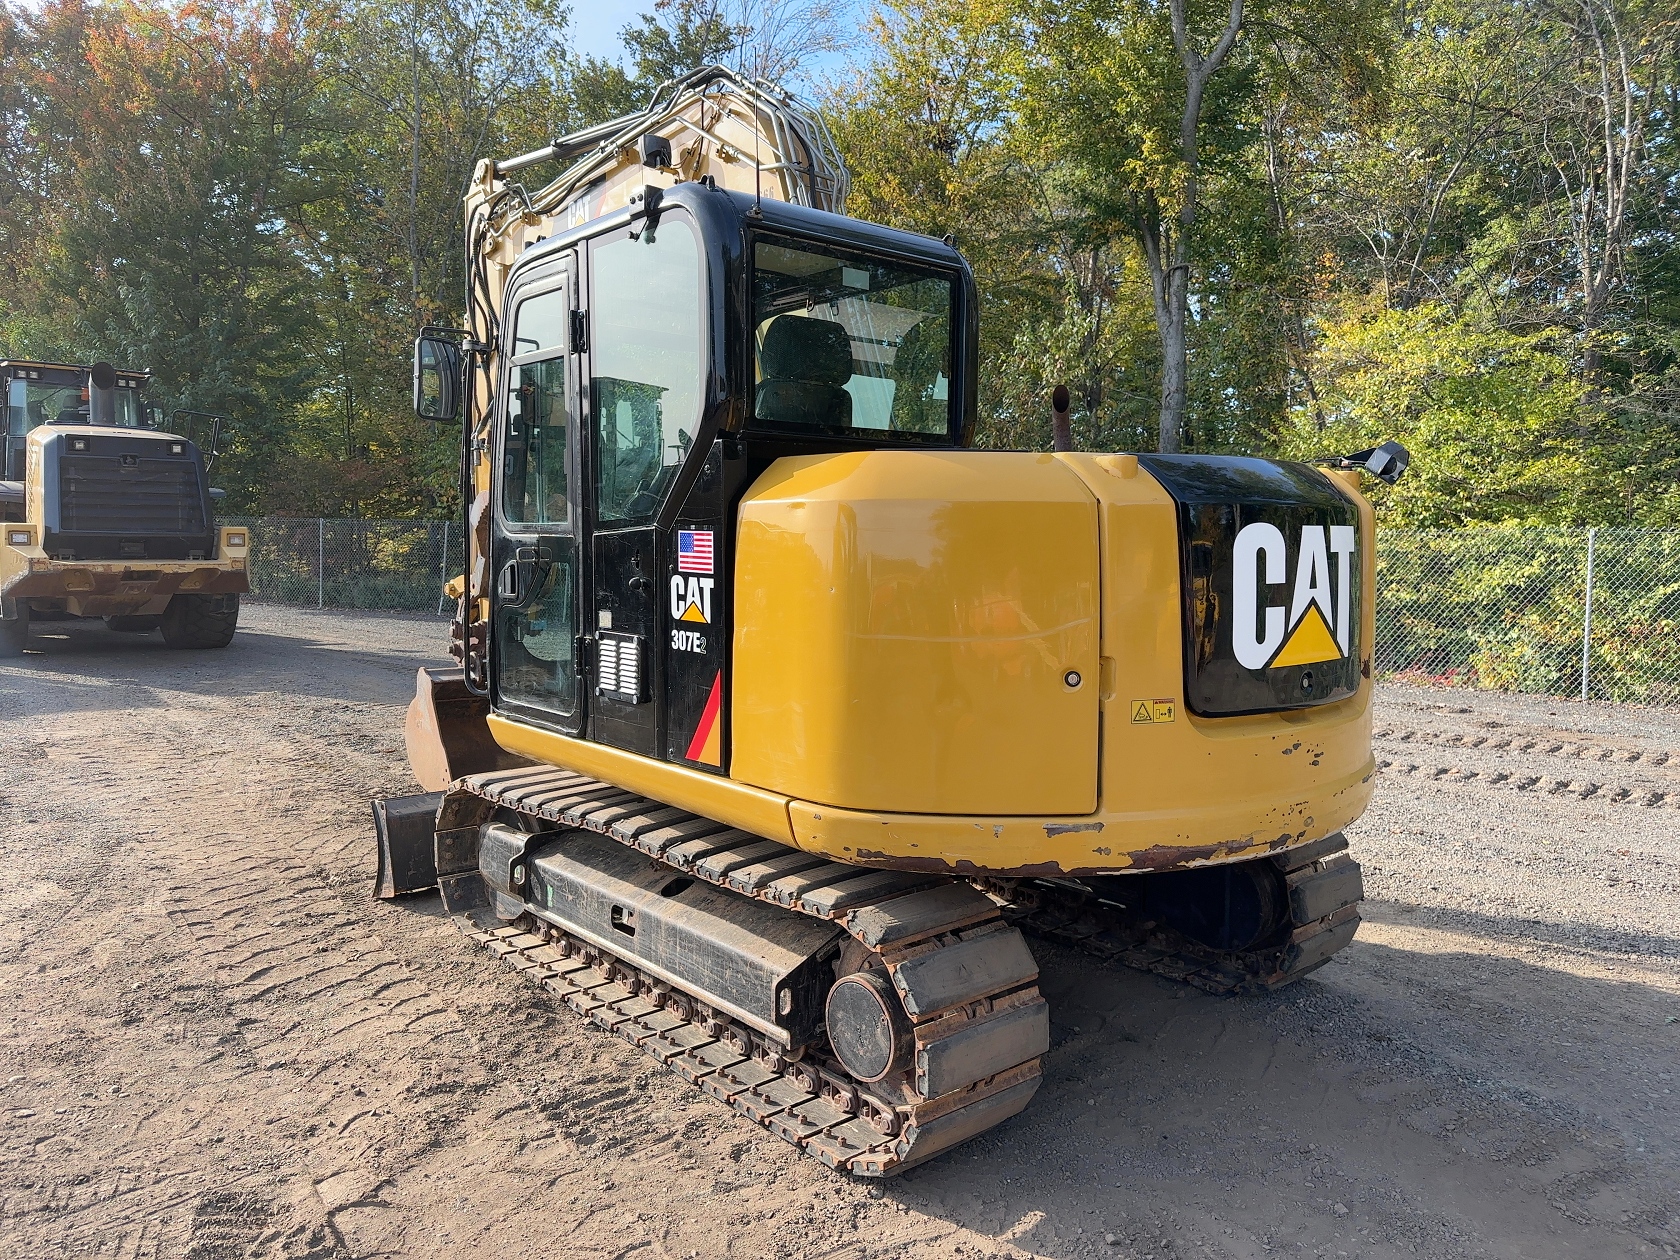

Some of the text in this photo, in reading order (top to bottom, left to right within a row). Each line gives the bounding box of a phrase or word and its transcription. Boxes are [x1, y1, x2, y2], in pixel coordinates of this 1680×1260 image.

[567, 194, 591, 230] CAT
[670, 574, 715, 624] CAT
[1232, 522, 1355, 670] CAT
[671, 629, 707, 655] 307E2
